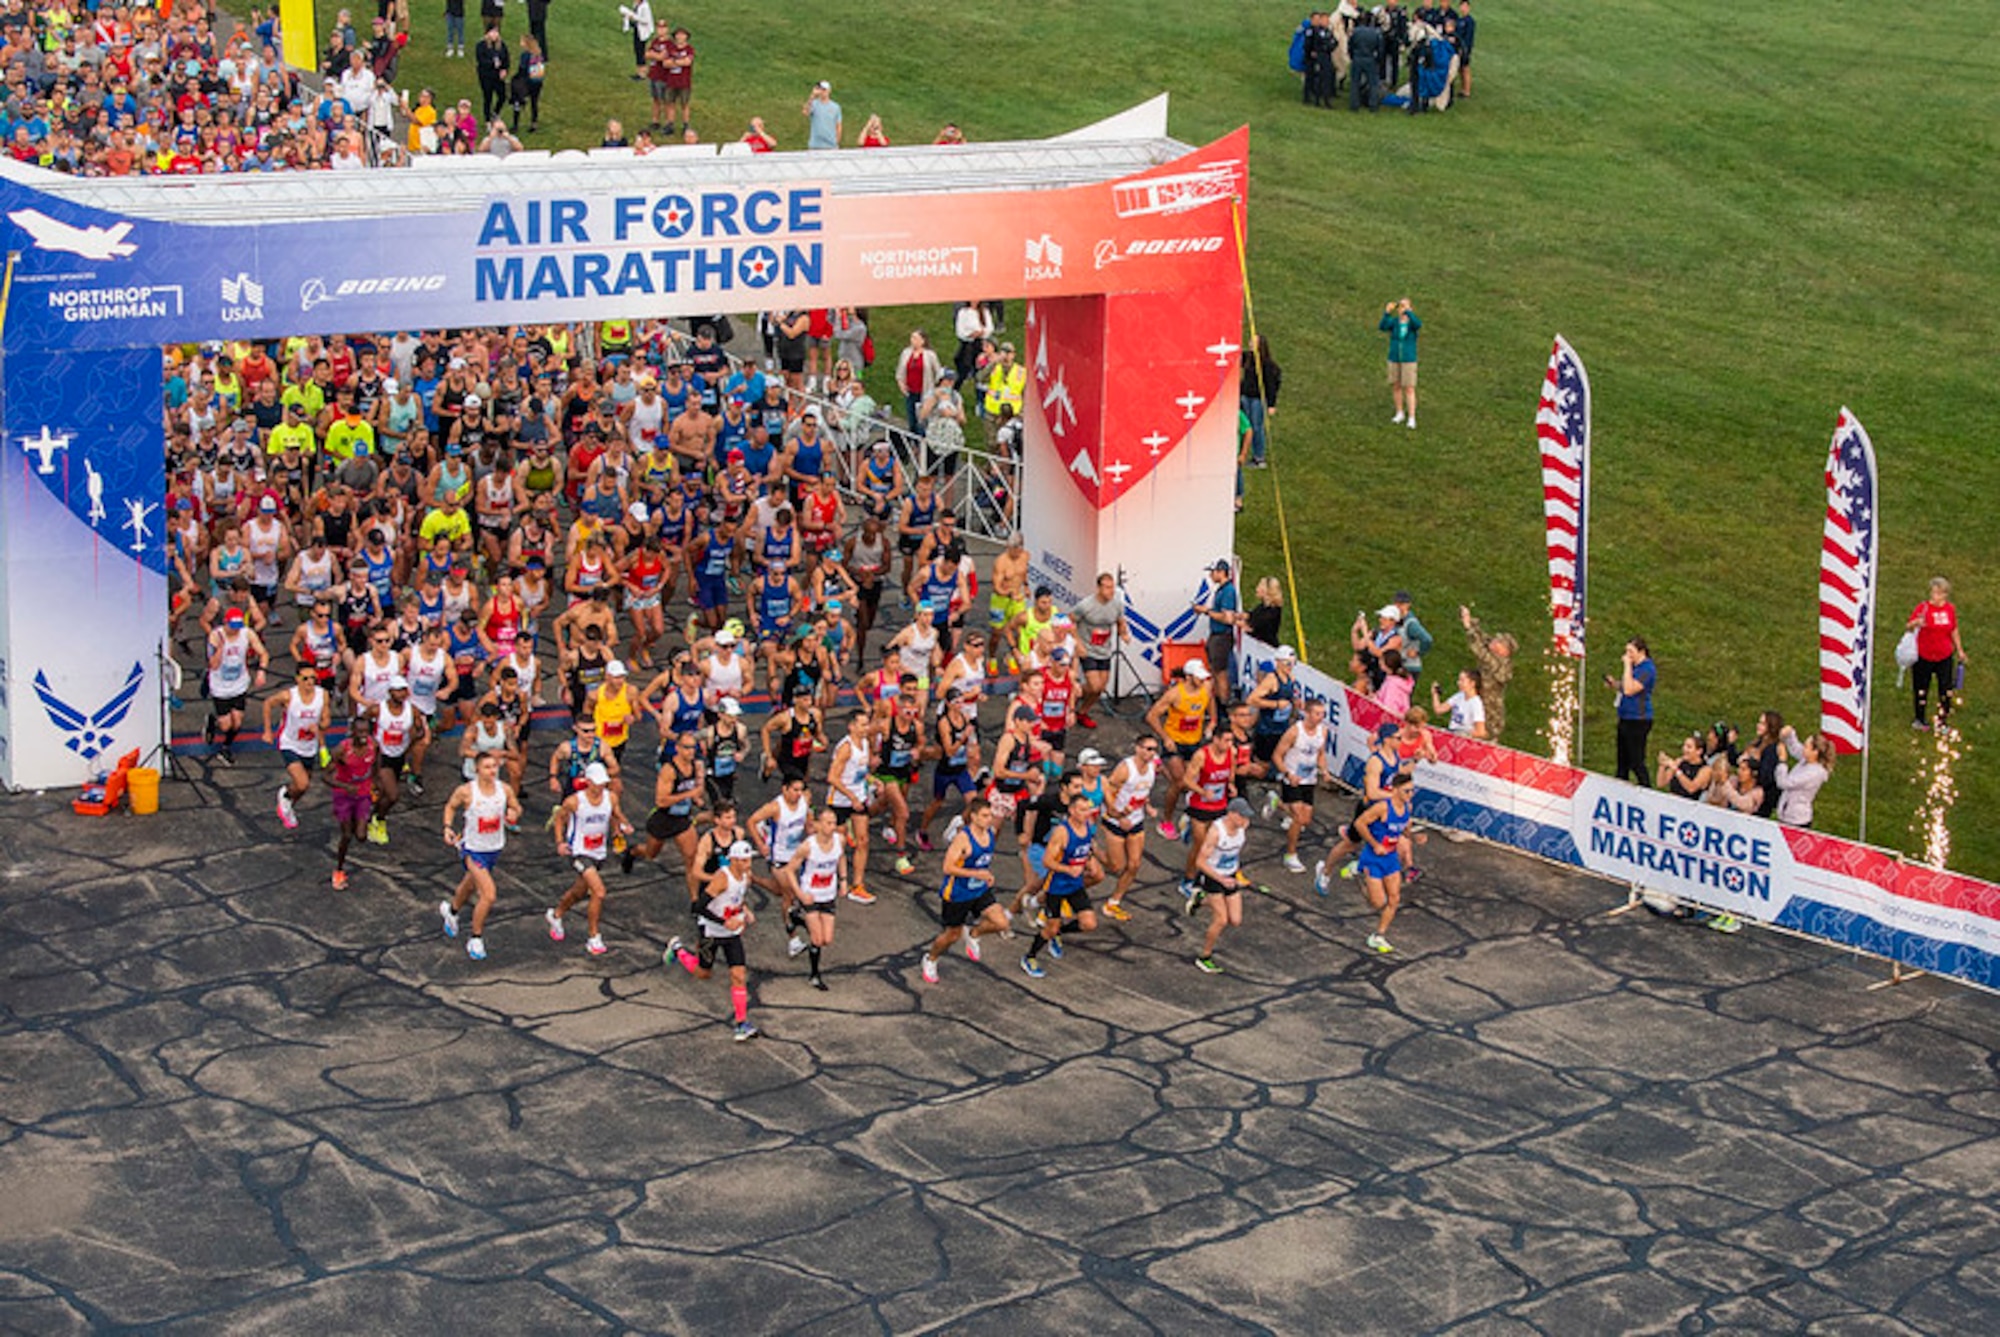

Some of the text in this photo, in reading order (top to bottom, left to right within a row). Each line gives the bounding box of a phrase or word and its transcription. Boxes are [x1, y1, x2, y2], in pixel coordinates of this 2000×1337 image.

[477, 188, 822, 246] AIR FORCE
[1125, 236, 1224, 255] BOEING
[860, 247, 950, 265] NORTHROP
[475, 243, 823, 302] MARATHON
[872, 261, 963, 279] GRUMMAN
[1025, 266, 1063, 281] USAA
[335, 275, 446, 295] BOEING
[48, 287, 152, 306] NORTHROP
[64, 302, 167, 322] GRUMMAN
[221, 306, 264, 321] USAA
[1592, 796, 1771, 868] AIR FORCE
[1591, 826, 1771, 901] MARATHON
